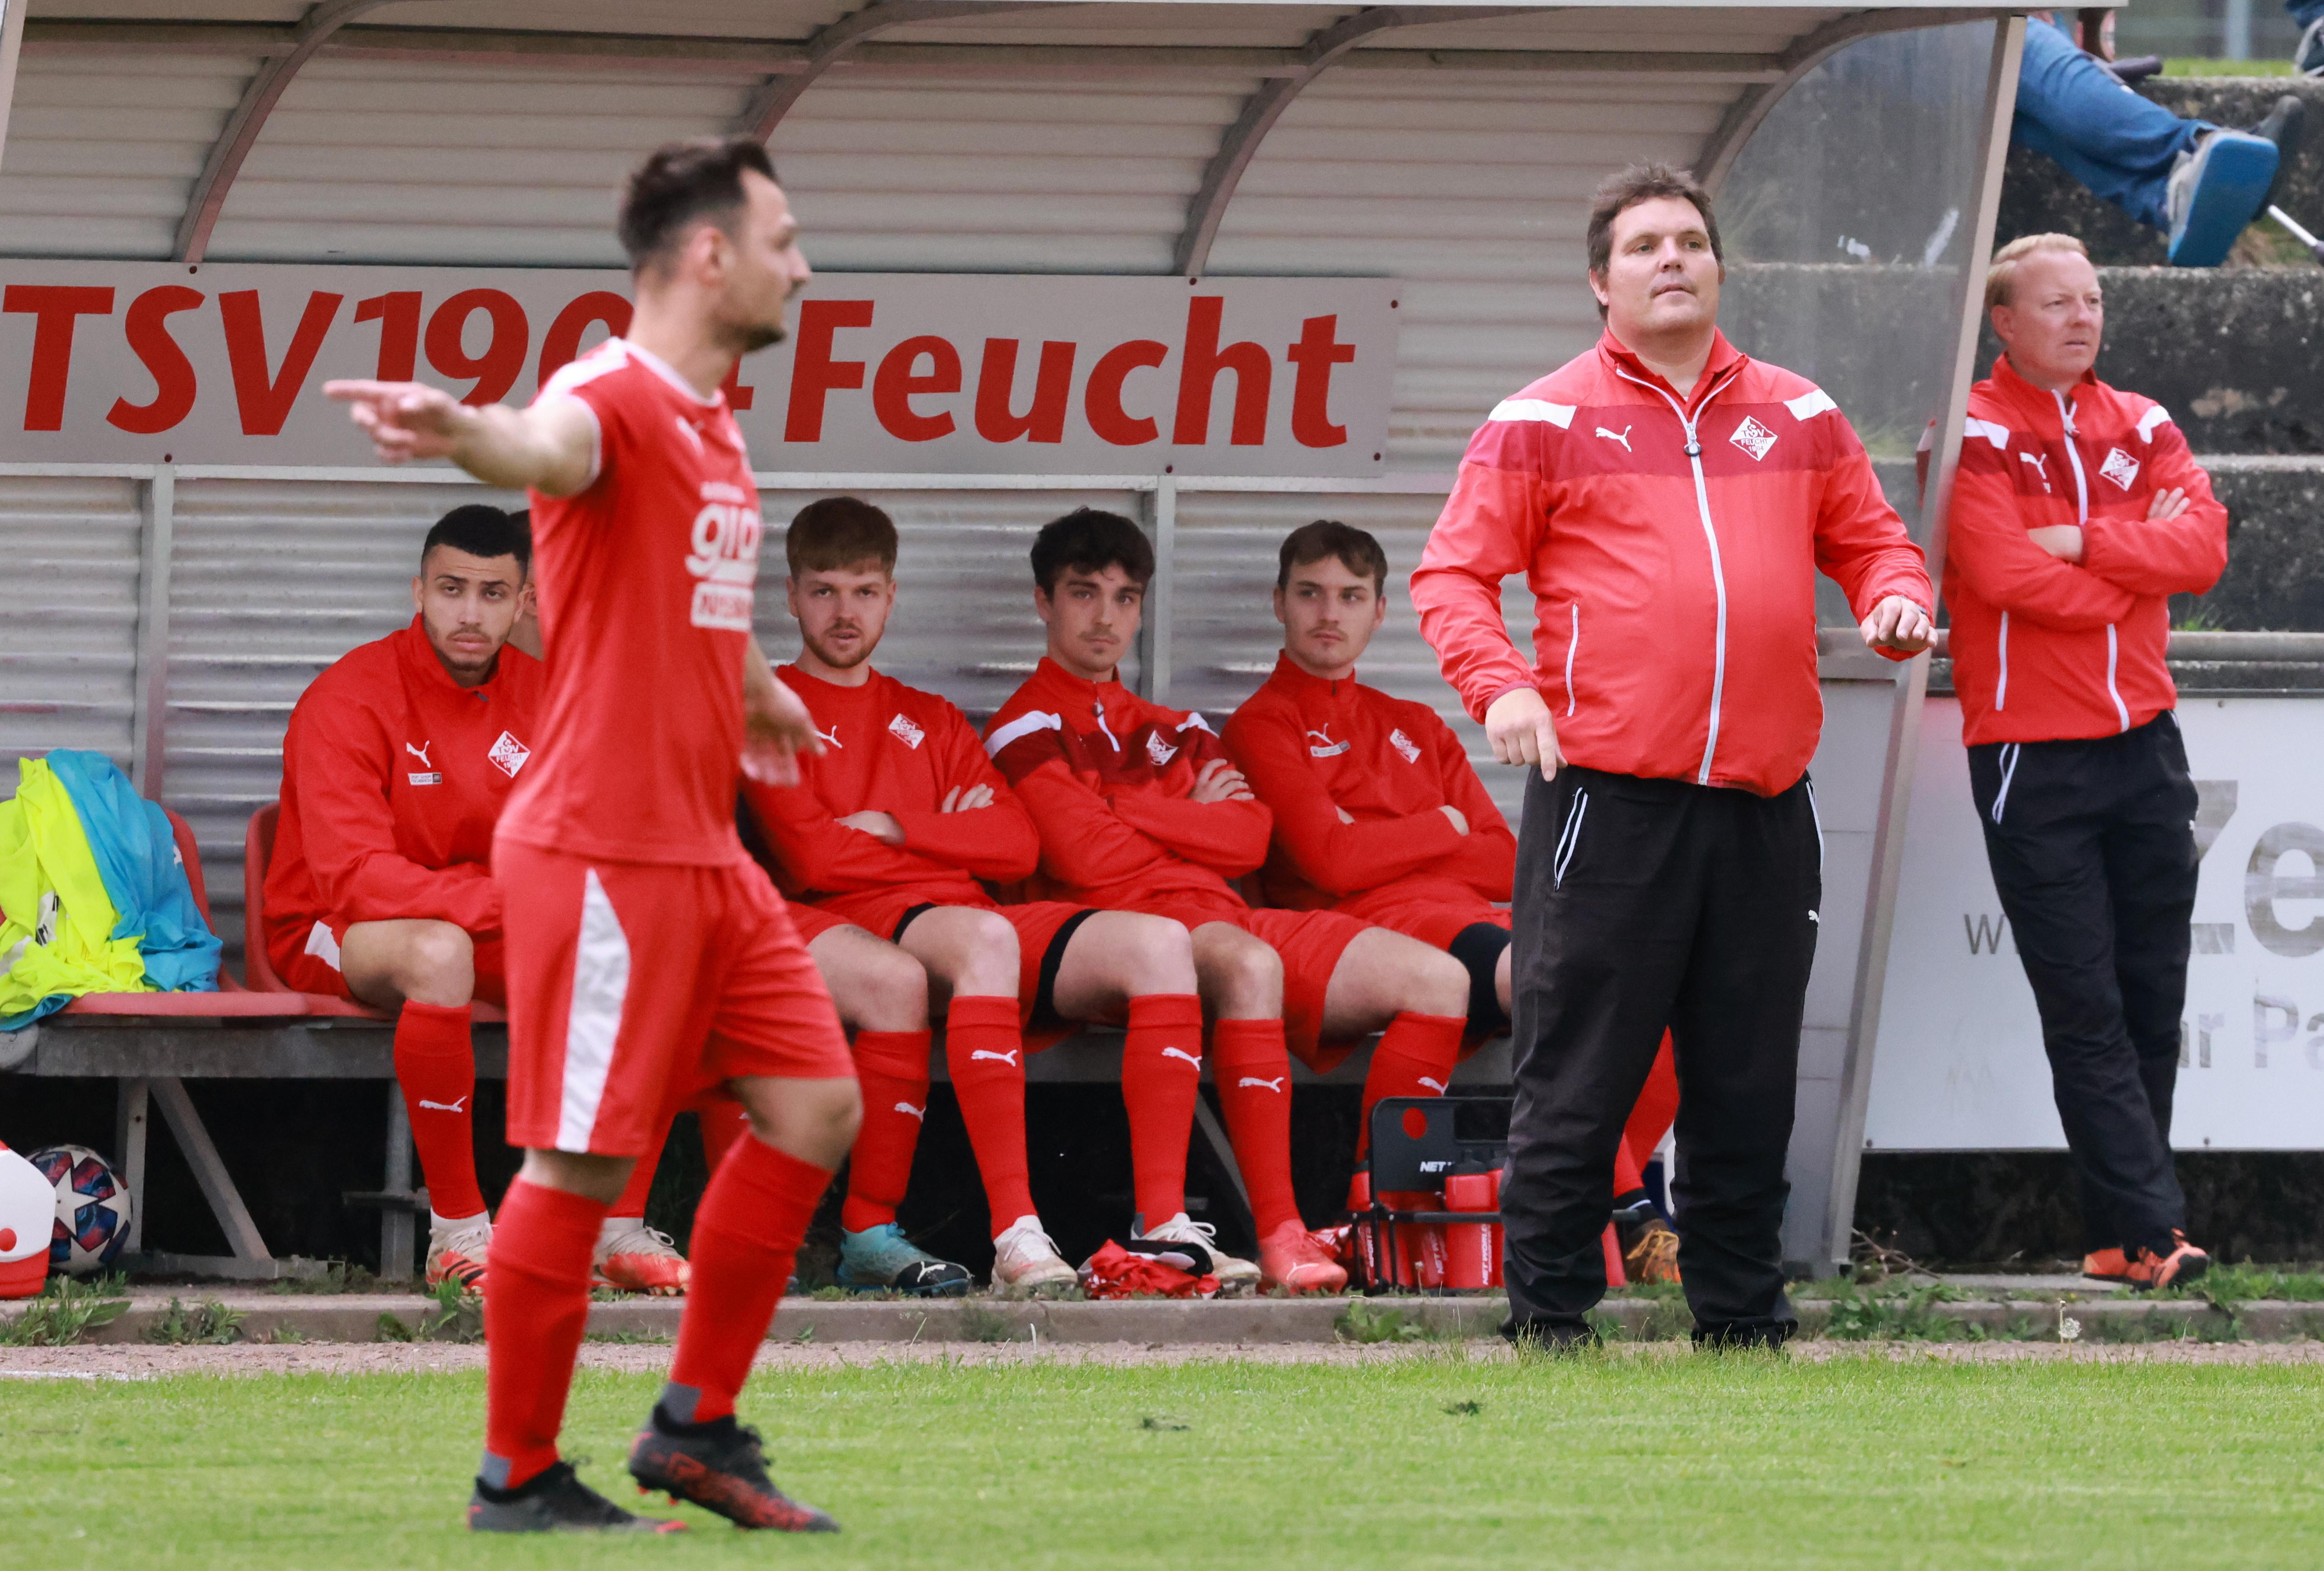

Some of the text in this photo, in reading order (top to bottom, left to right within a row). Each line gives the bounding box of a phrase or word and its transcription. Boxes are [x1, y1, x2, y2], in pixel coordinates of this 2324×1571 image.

[784, 296, 1356, 448] Feucht
[1741, 424, 1764, 438] TSV
[1420, 1161, 1447, 1173] NET
